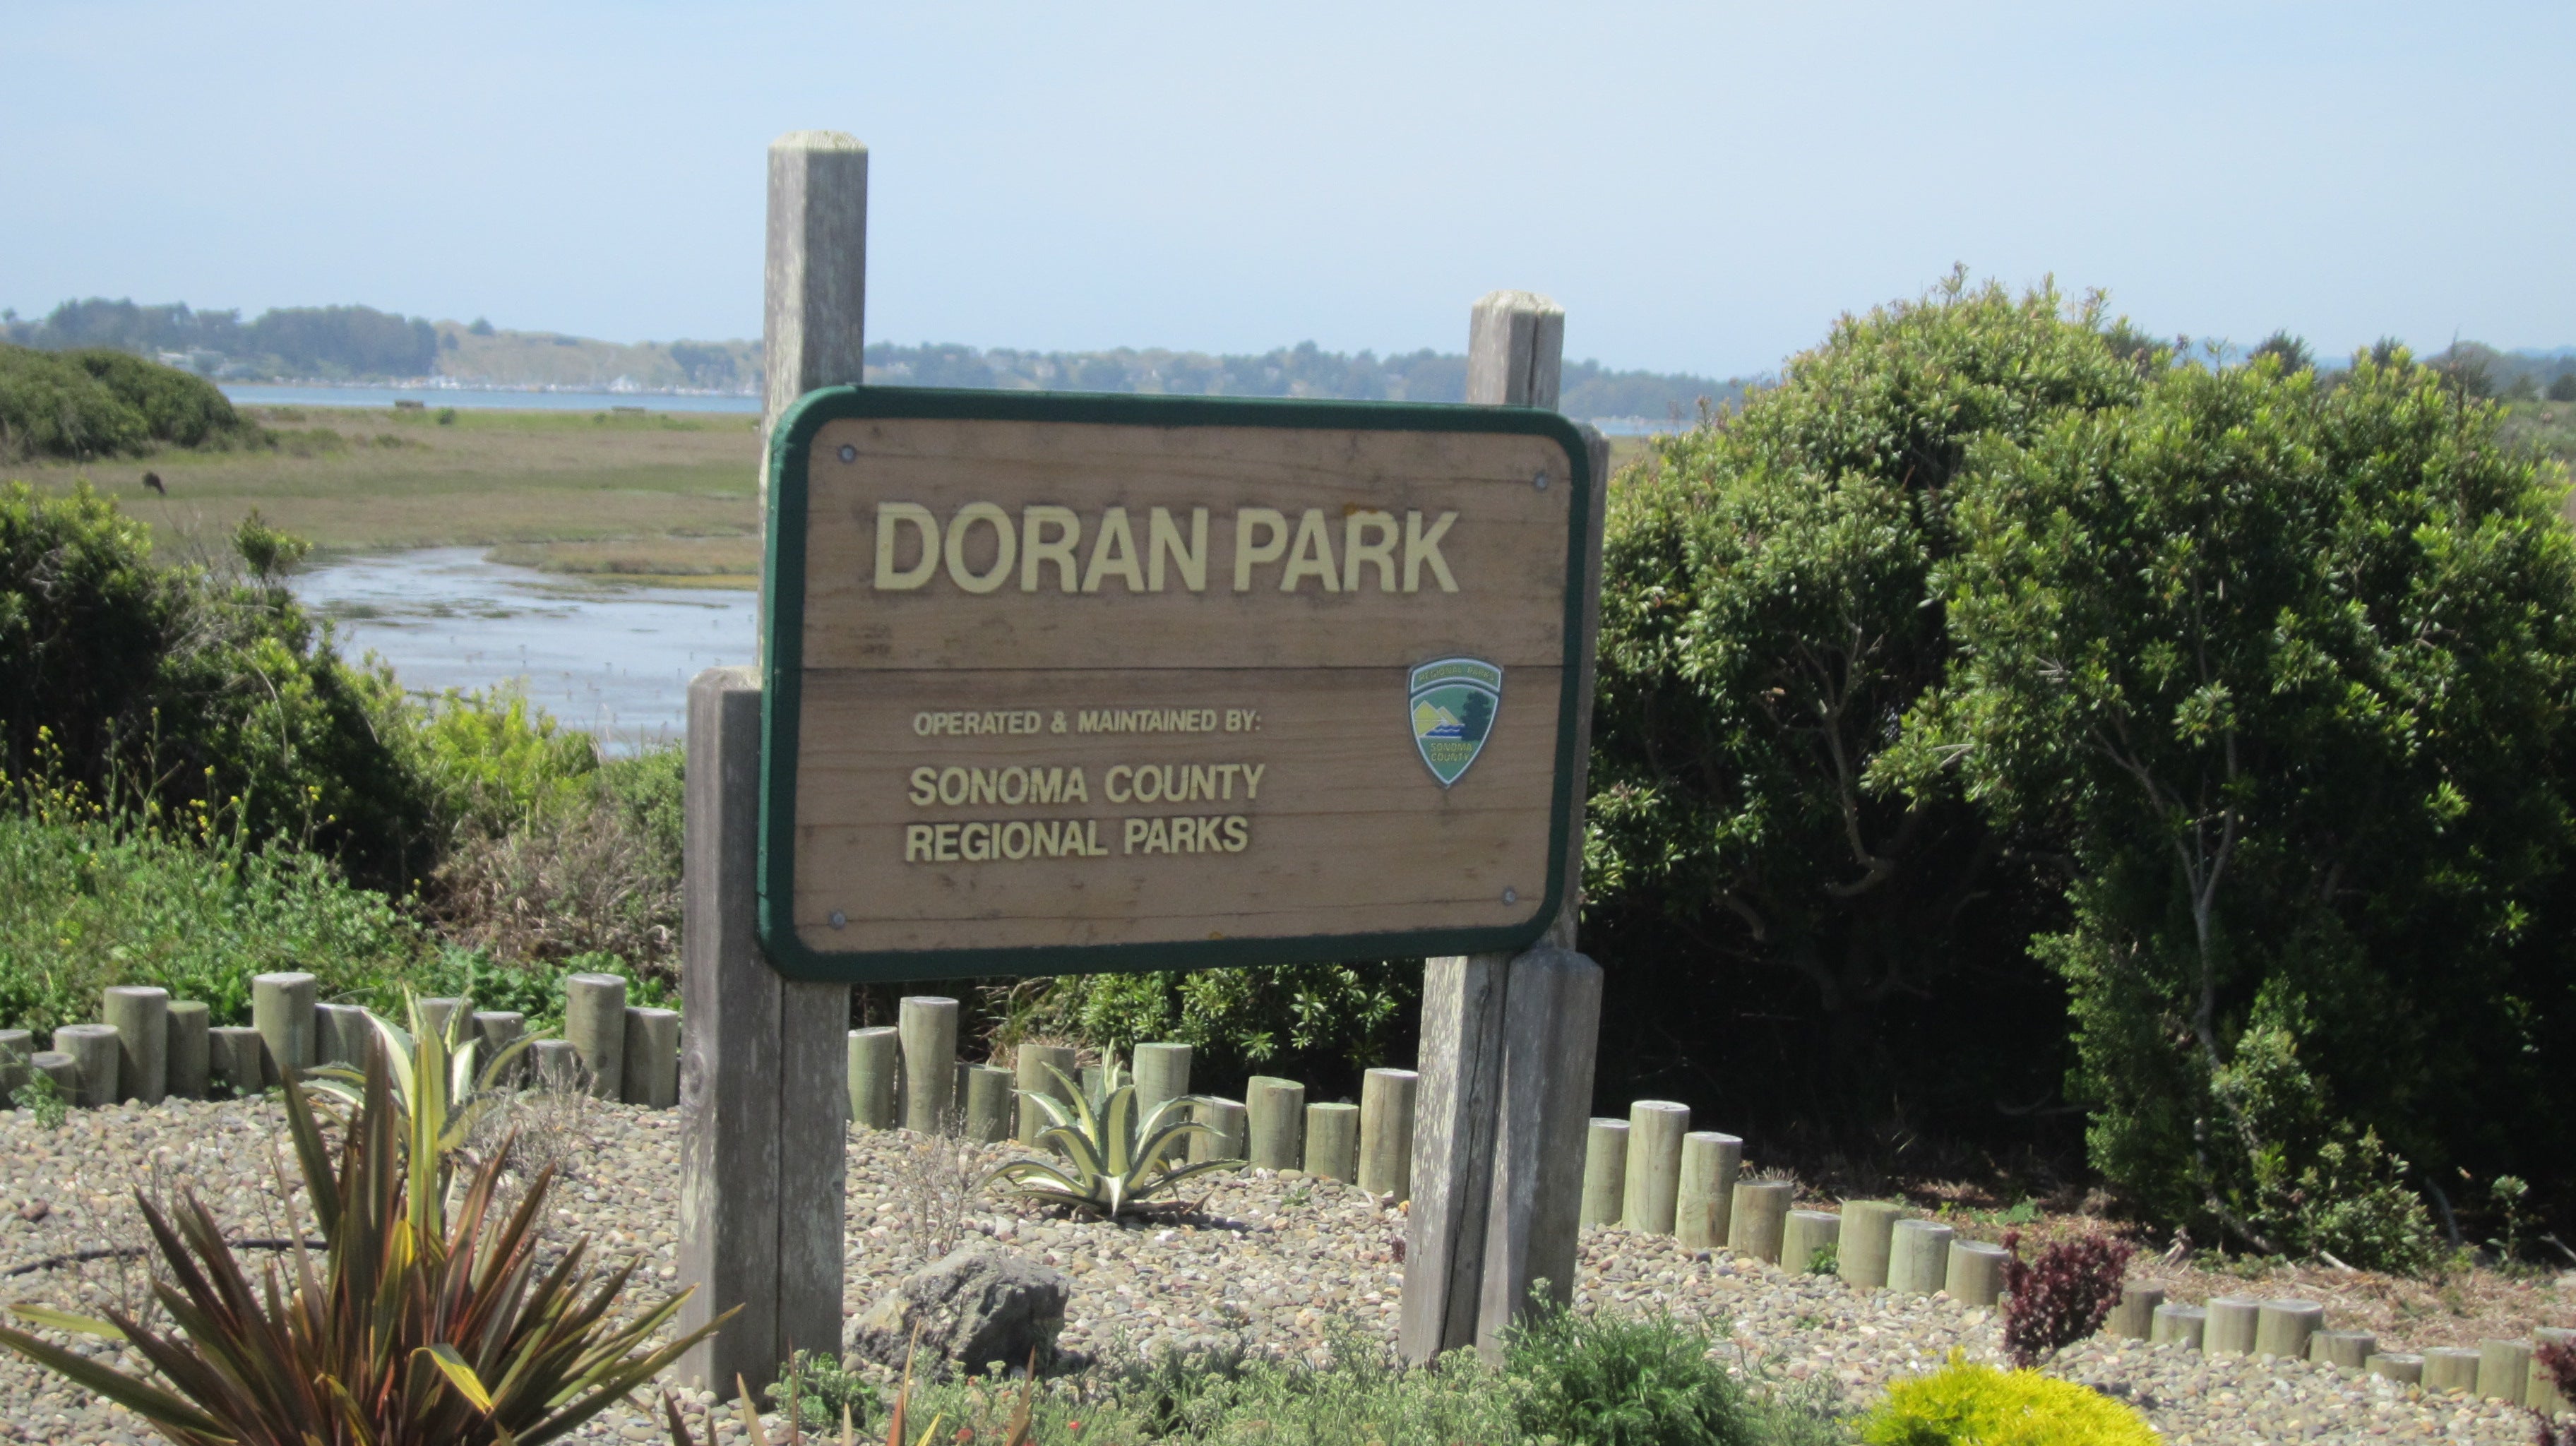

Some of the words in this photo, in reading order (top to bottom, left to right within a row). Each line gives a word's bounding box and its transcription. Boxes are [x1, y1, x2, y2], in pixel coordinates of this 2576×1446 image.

[873, 501, 1209, 594] DORAN
[1234, 507, 1460, 593] PARK
[1418, 666, 1462, 682] REGIONAL
[1467, 667, 1495, 681] PARKS
[913, 711, 1041, 735] OPERATED
[1050, 710, 1067, 734] &
[1078, 709, 1217, 733] MAINTAINED
[1225, 709, 1261, 731] BY:
[1431, 742, 1472, 752] SONOMA
[1431, 752, 1469, 763] COUNTY
[908, 765, 1088, 806] SONOMA
[1104, 763, 1265, 803] COUNTY
[905, 820, 1108, 862] REGIONAL
[1124, 815, 1248, 854] PARKS
